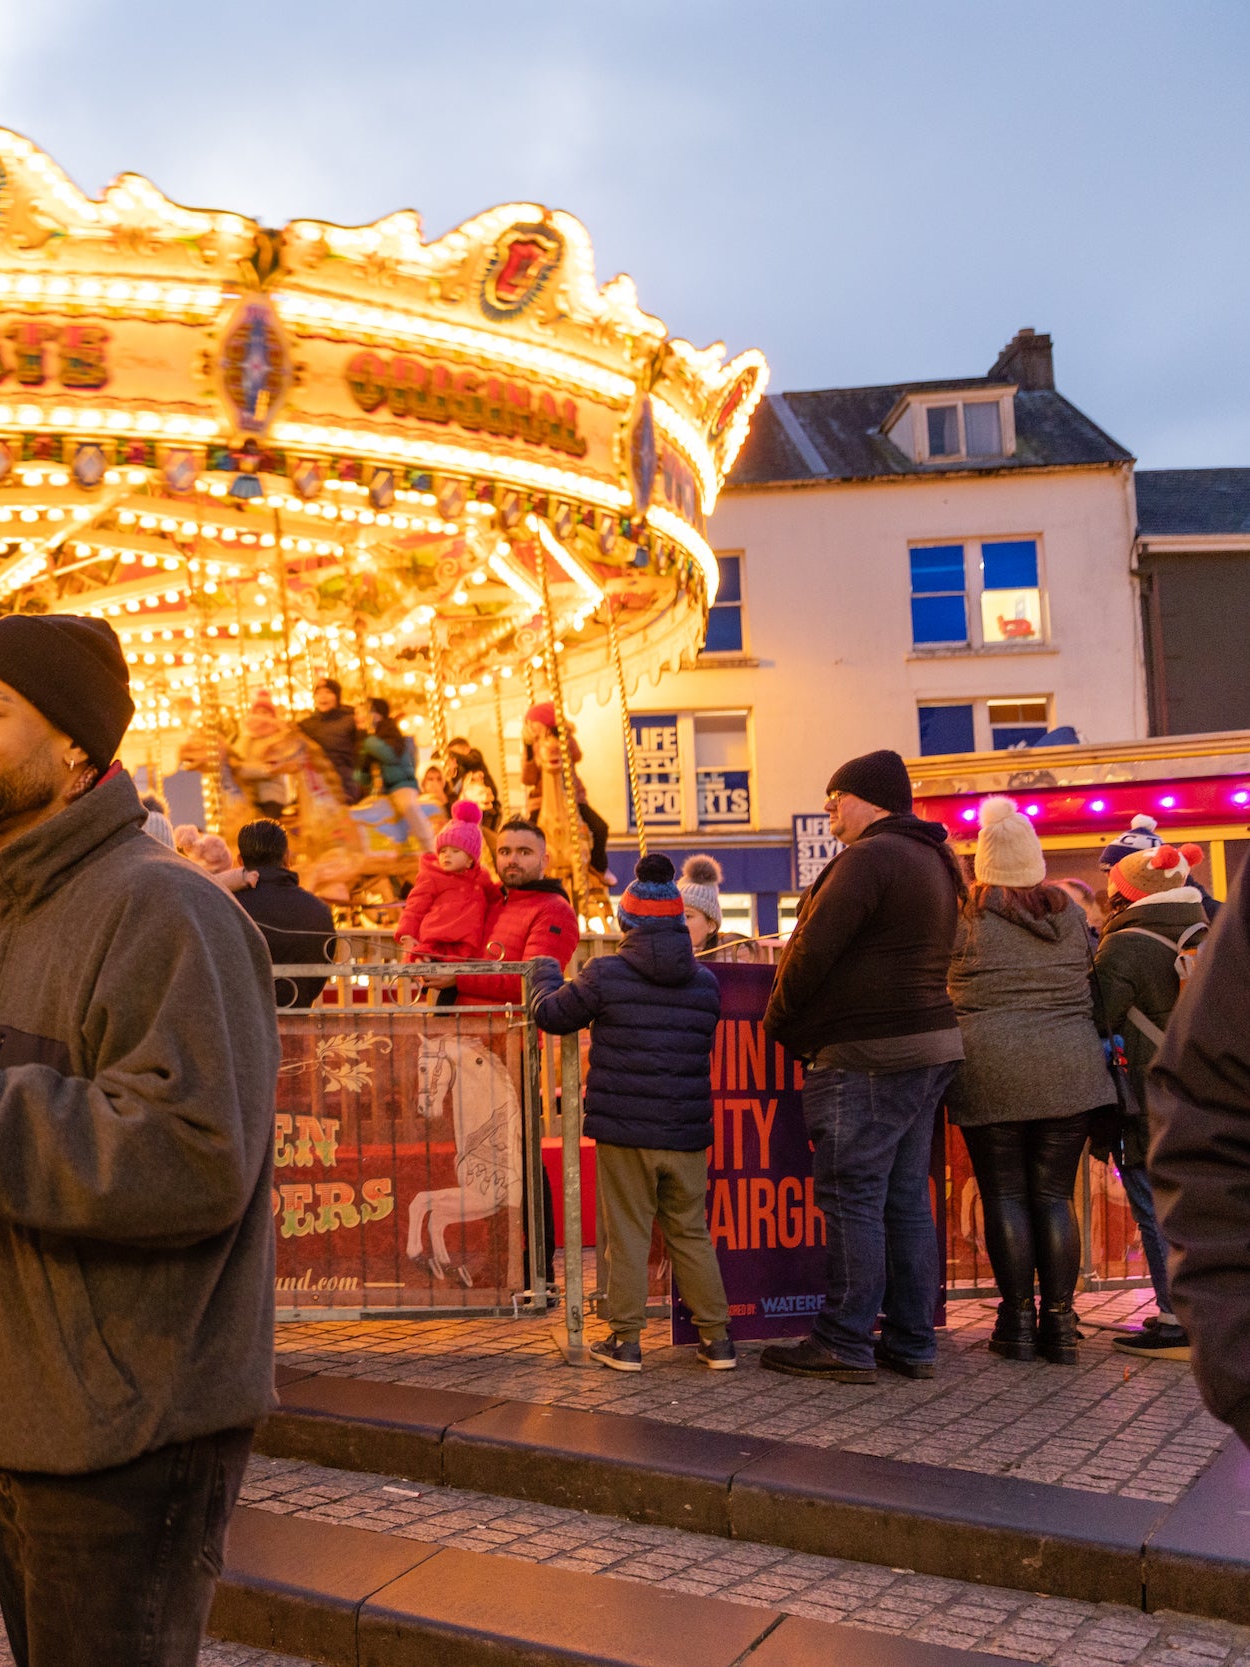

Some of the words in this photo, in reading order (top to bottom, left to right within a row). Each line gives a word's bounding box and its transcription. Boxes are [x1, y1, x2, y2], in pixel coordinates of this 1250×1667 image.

[631, 727, 677, 751] LIFE
[707, 1099, 778, 1170] ITY
[761, 1294, 827, 1312] WATERF
